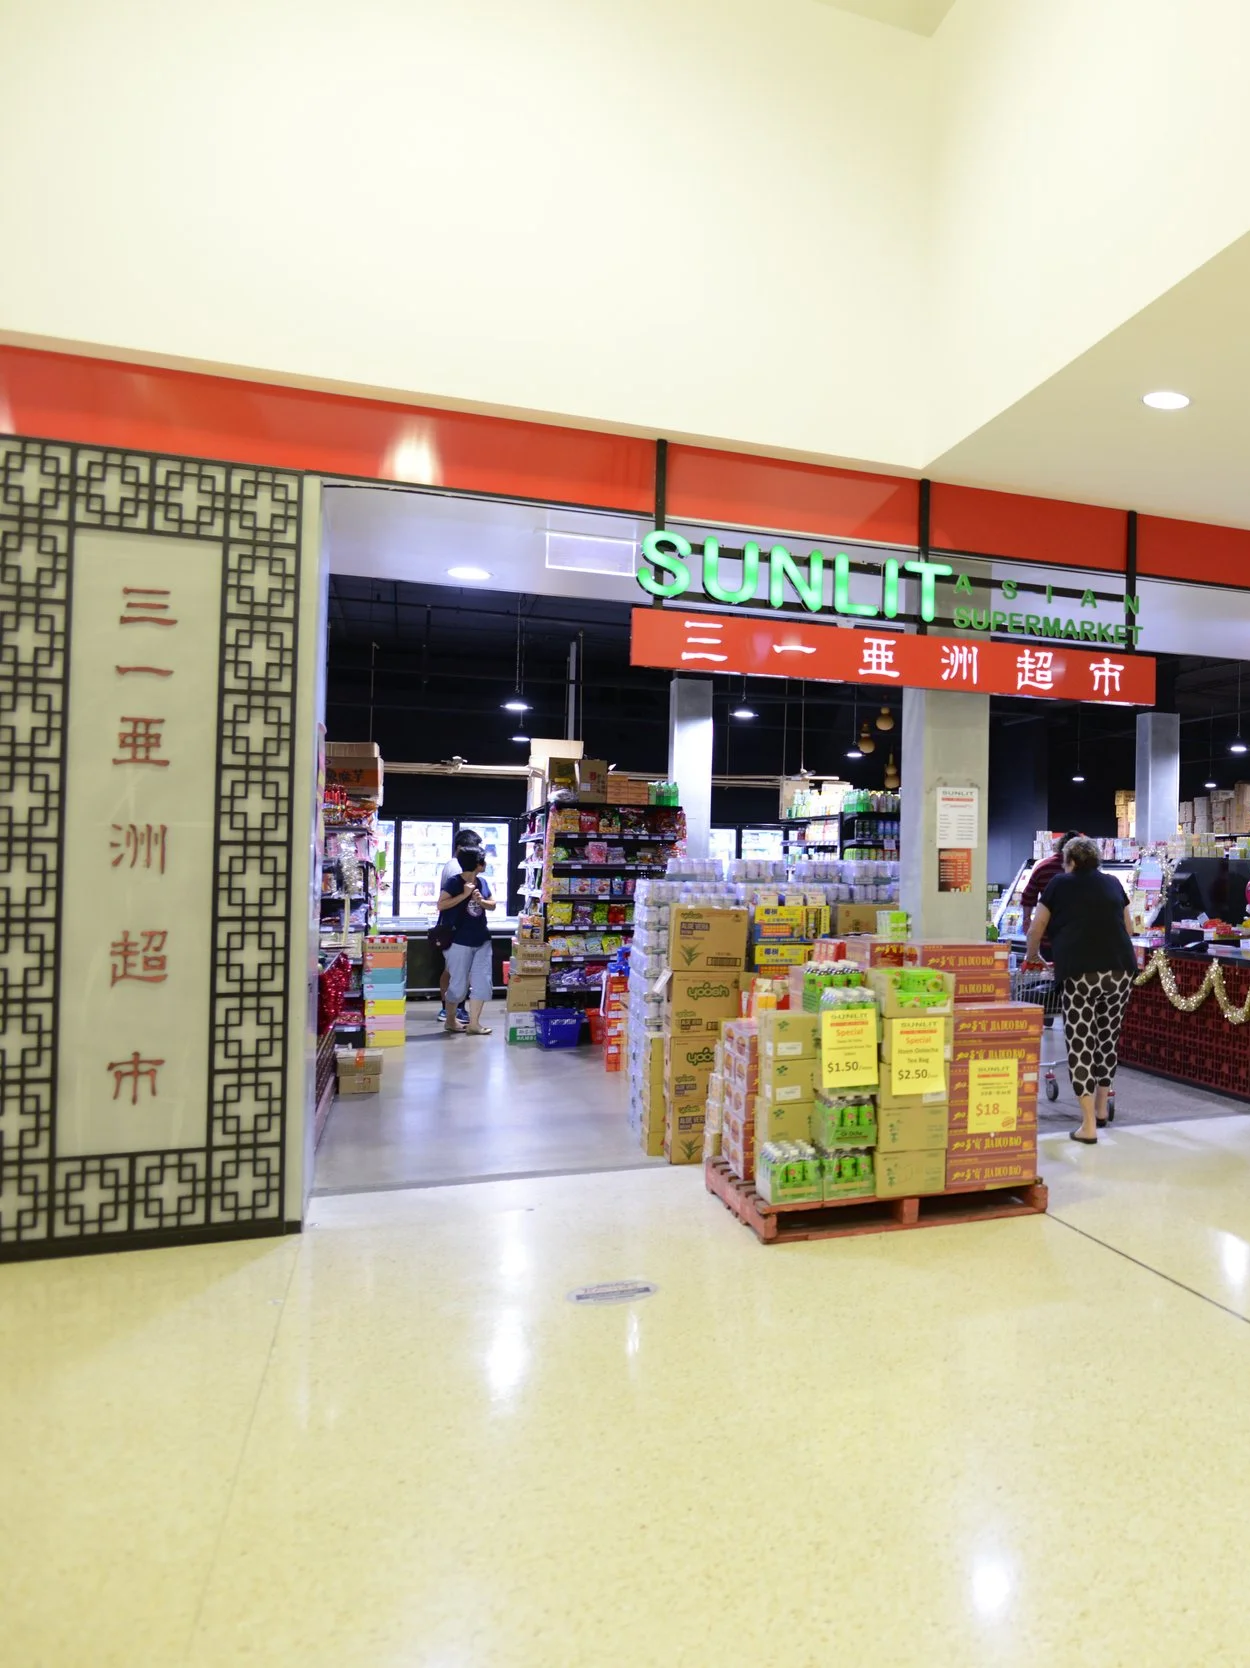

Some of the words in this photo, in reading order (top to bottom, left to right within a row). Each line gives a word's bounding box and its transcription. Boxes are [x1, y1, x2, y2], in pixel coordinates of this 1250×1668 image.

[636, 530, 953, 622] SUNLIT
[954, 573, 1140, 615] ASIAN
[953, 606, 1144, 646] SUPERMARKET
[836, 1028, 863, 1037] Special
[905, 1036, 932, 1045] Special
[976, 1103, 1000, 1116] $18
